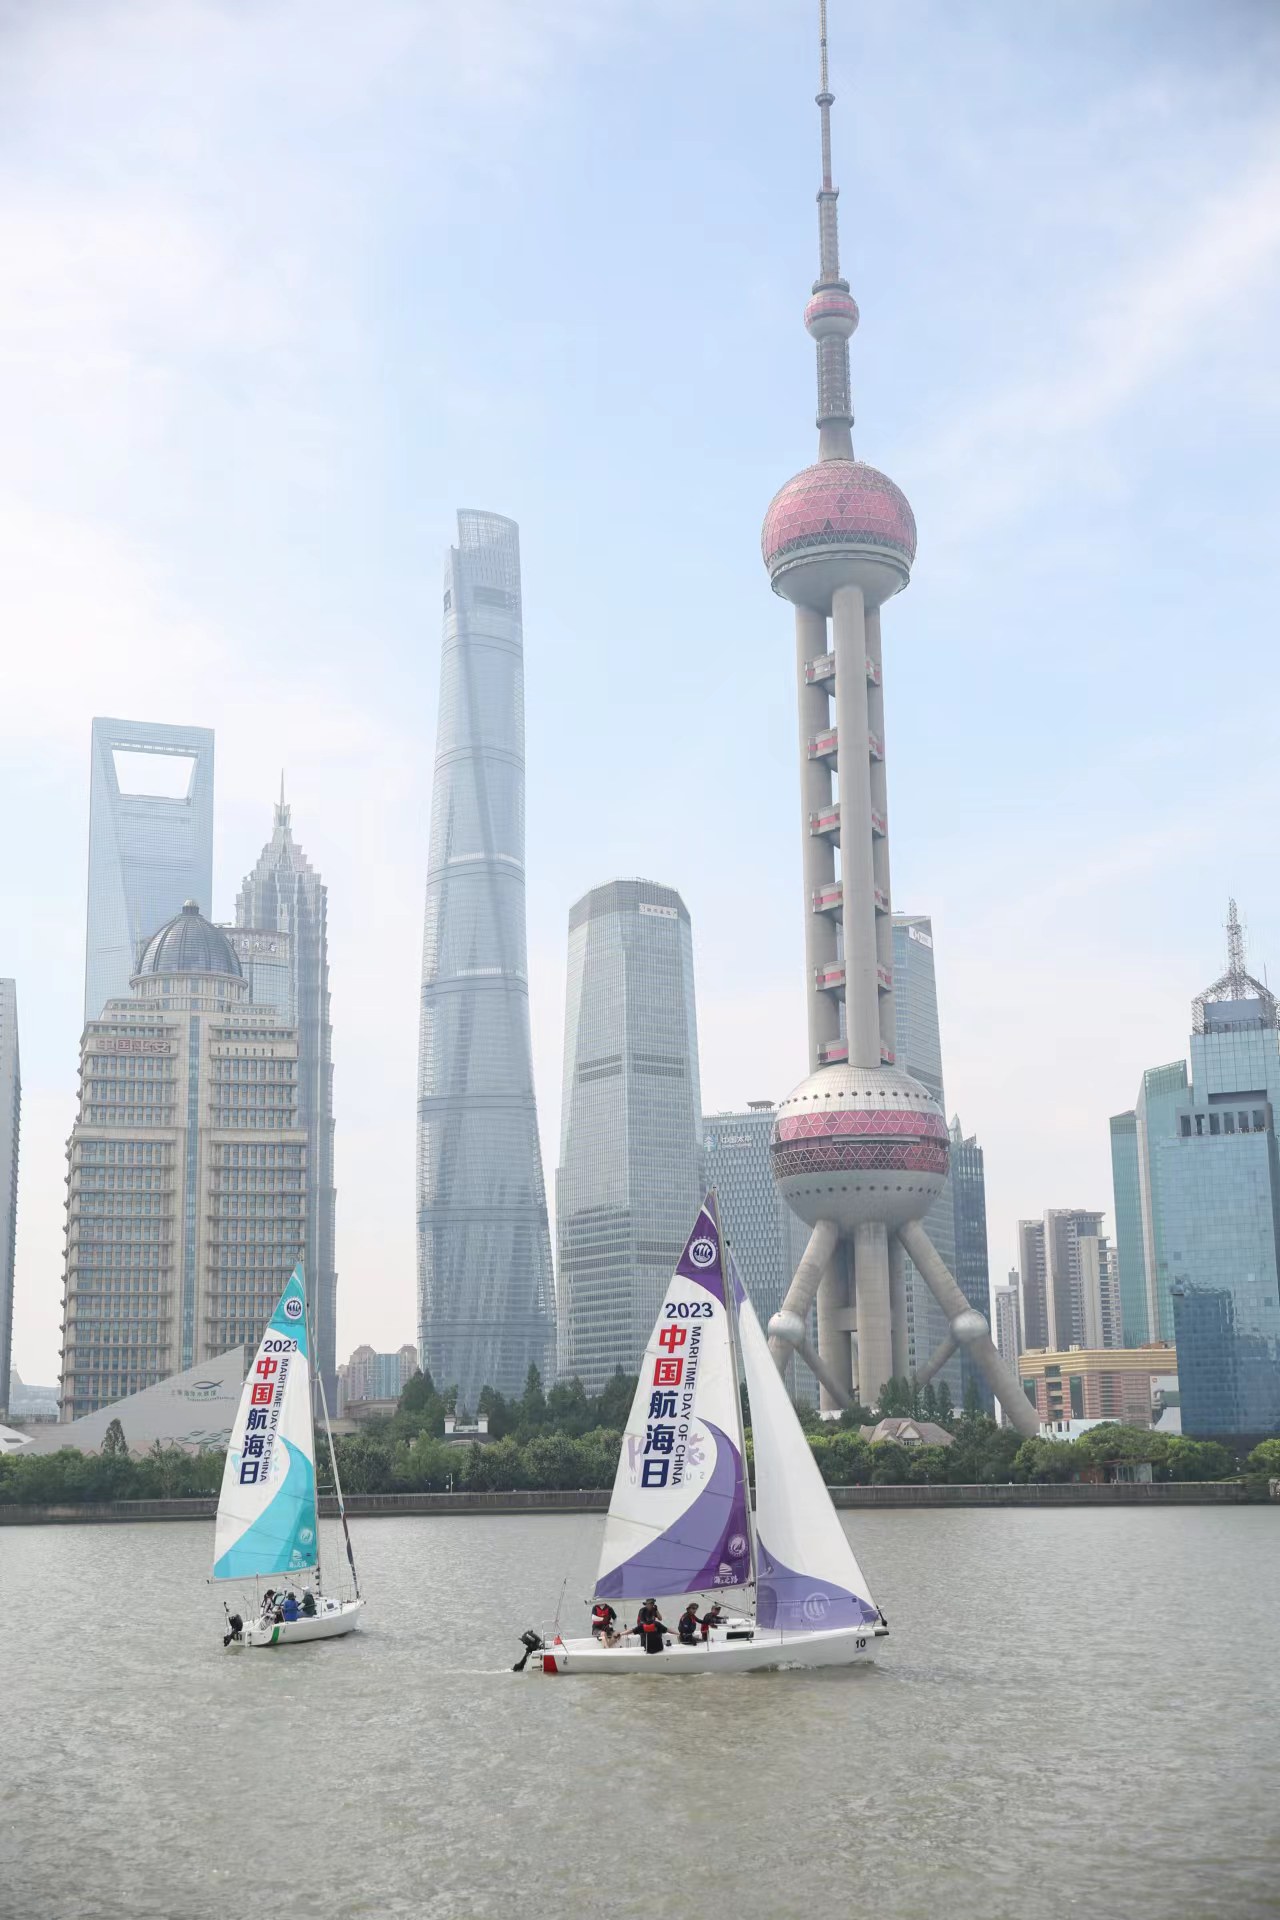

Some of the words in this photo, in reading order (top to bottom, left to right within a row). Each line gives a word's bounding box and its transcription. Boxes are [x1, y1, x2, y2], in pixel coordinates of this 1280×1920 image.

[96, 1038, 172, 1054] 中国平安
[664, 1302, 714, 1319] 2023
[263, 1339, 298, 1353] 2023
[683, 1326, 702, 1390] MARITIME
[273, 1358, 289, 1408] MARITIME
[641, 1323, 687, 1488] 中国航海日
[680, 1393, 694, 1421] DAY
[239, 1356, 278, 1485] 中国航海日
[269, 1410, 280, 1431] DAY
[677, 1423, 689, 1442] OF
[266, 1433, 275, 1448] OF
[260, 1449, 272, 1482] CHINA
[671, 1444, 686, 1486] CHINA
[855, 1638, 866, 1649] 10
